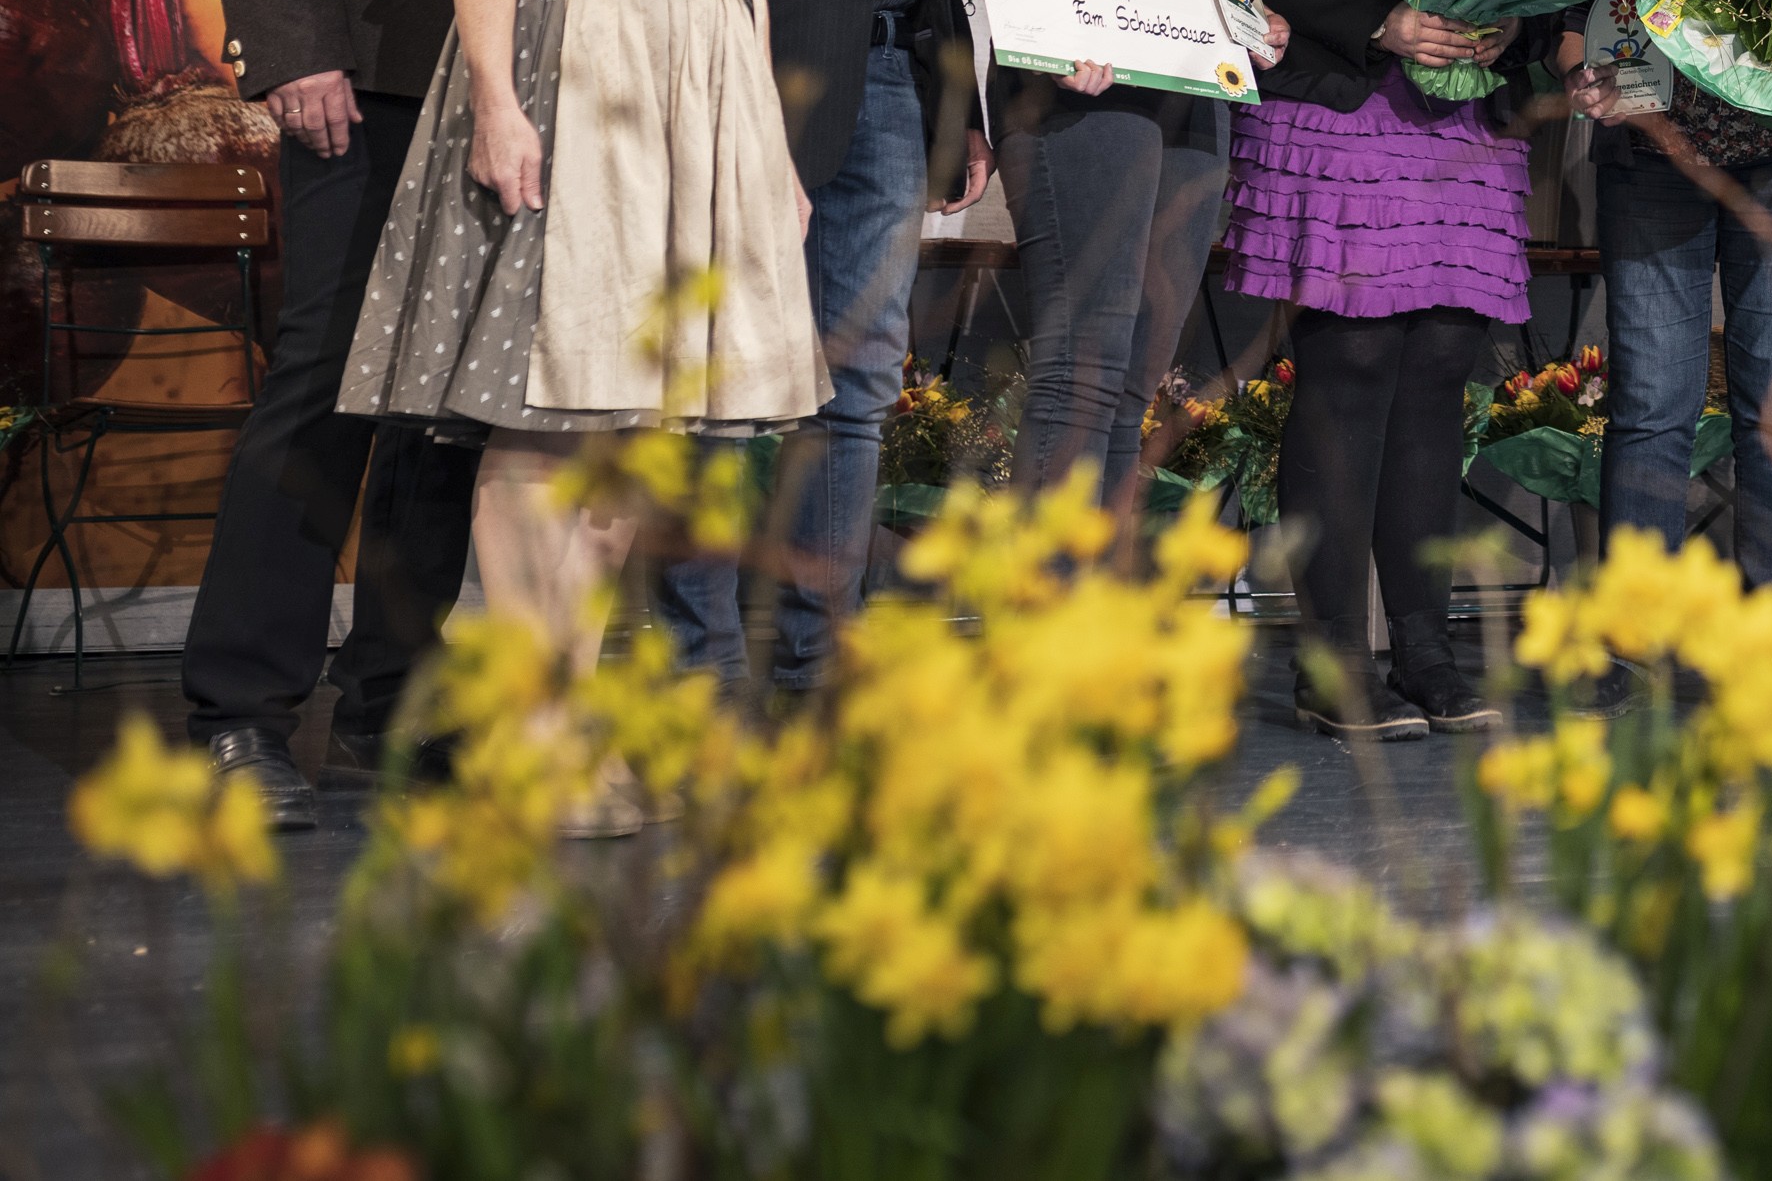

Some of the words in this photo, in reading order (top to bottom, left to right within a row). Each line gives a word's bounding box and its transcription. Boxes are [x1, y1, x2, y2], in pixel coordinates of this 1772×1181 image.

[1073, 0, 1107, 28] Fam.
[1116, 6, 1216, 44] Schickbauer
[1617, 79, 1661, 90] ezeichnet
